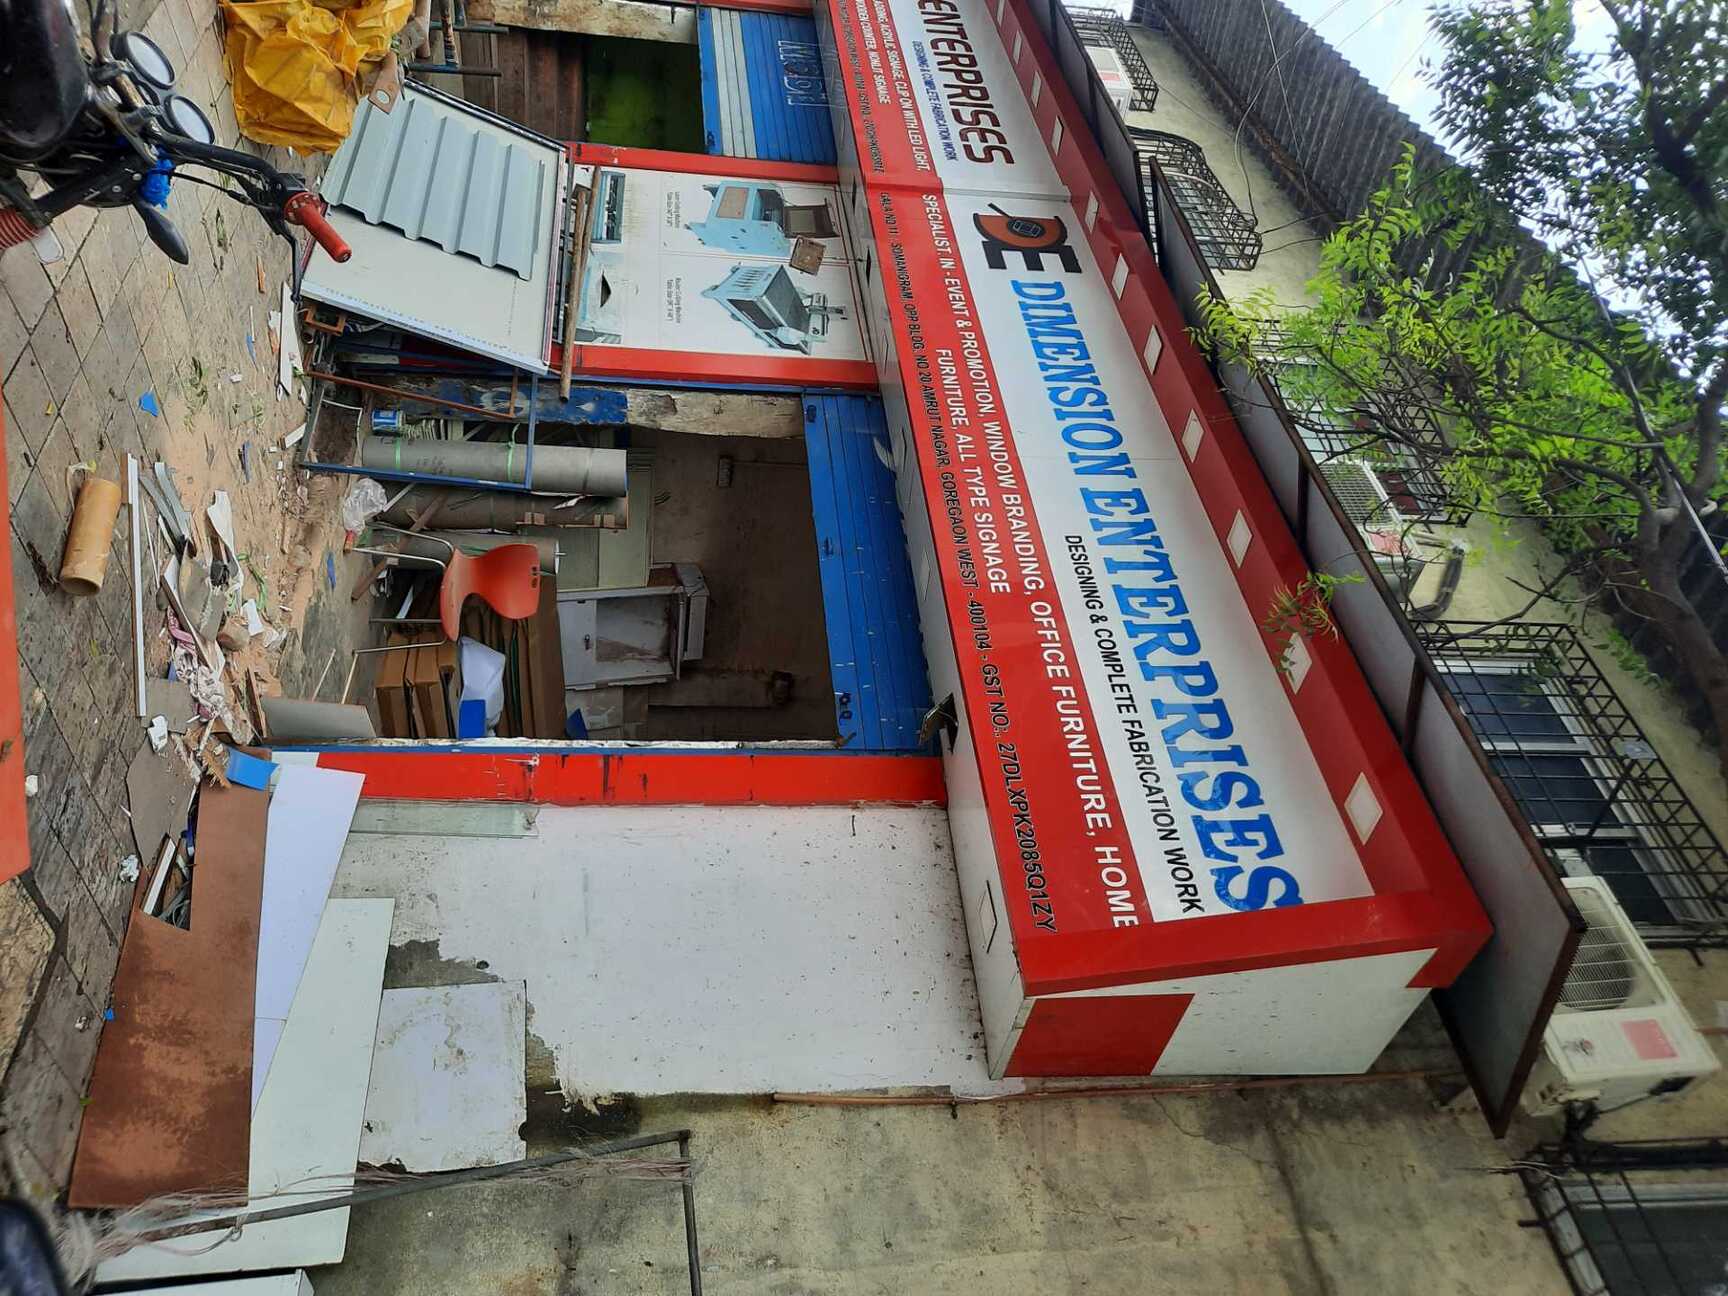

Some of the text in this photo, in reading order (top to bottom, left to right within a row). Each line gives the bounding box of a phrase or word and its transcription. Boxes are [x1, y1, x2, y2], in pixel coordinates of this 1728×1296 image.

[895, 81, 911, 98] CLIP
[899, 98, 914, 110] ON
[917, 0, 1014, 165] ENTERPRISES
[908, 129, 924, 146] LED
[938, 257, 956, 270] IN
[904, 303, 919, 322] OPP
[944, 278, 970, 316] EVENT
[955, 319, 971, 328] &
[916, 355, 929, 369] NO
[921, 384, 942, 422] AMRUT
[935, 349, 1011, 594] FURNITURE, ALL TYPE SIGNAGE
[982, 421, 1018, 489] WINDOW
[940, 471, 968, 545] GOREGAON
[1000, 493, 1045, 596] BRANDING,
[957, 548, 979, 588] WEST
[1010, 280, 1304, 912] DIMENSION ENTERPRISES
[967, 600, 992, 651] 400104
[1030, 601, 1070, 679] OFFICE
[981, 663, 1003, 697] GST
[1065, 535, 1205, 914] DESIGNING & COMPLETE FABRICATION WORK
[1051, 685, 1113, 837] FURNITURE,
[1094, 846, 1139, 928] HOME
